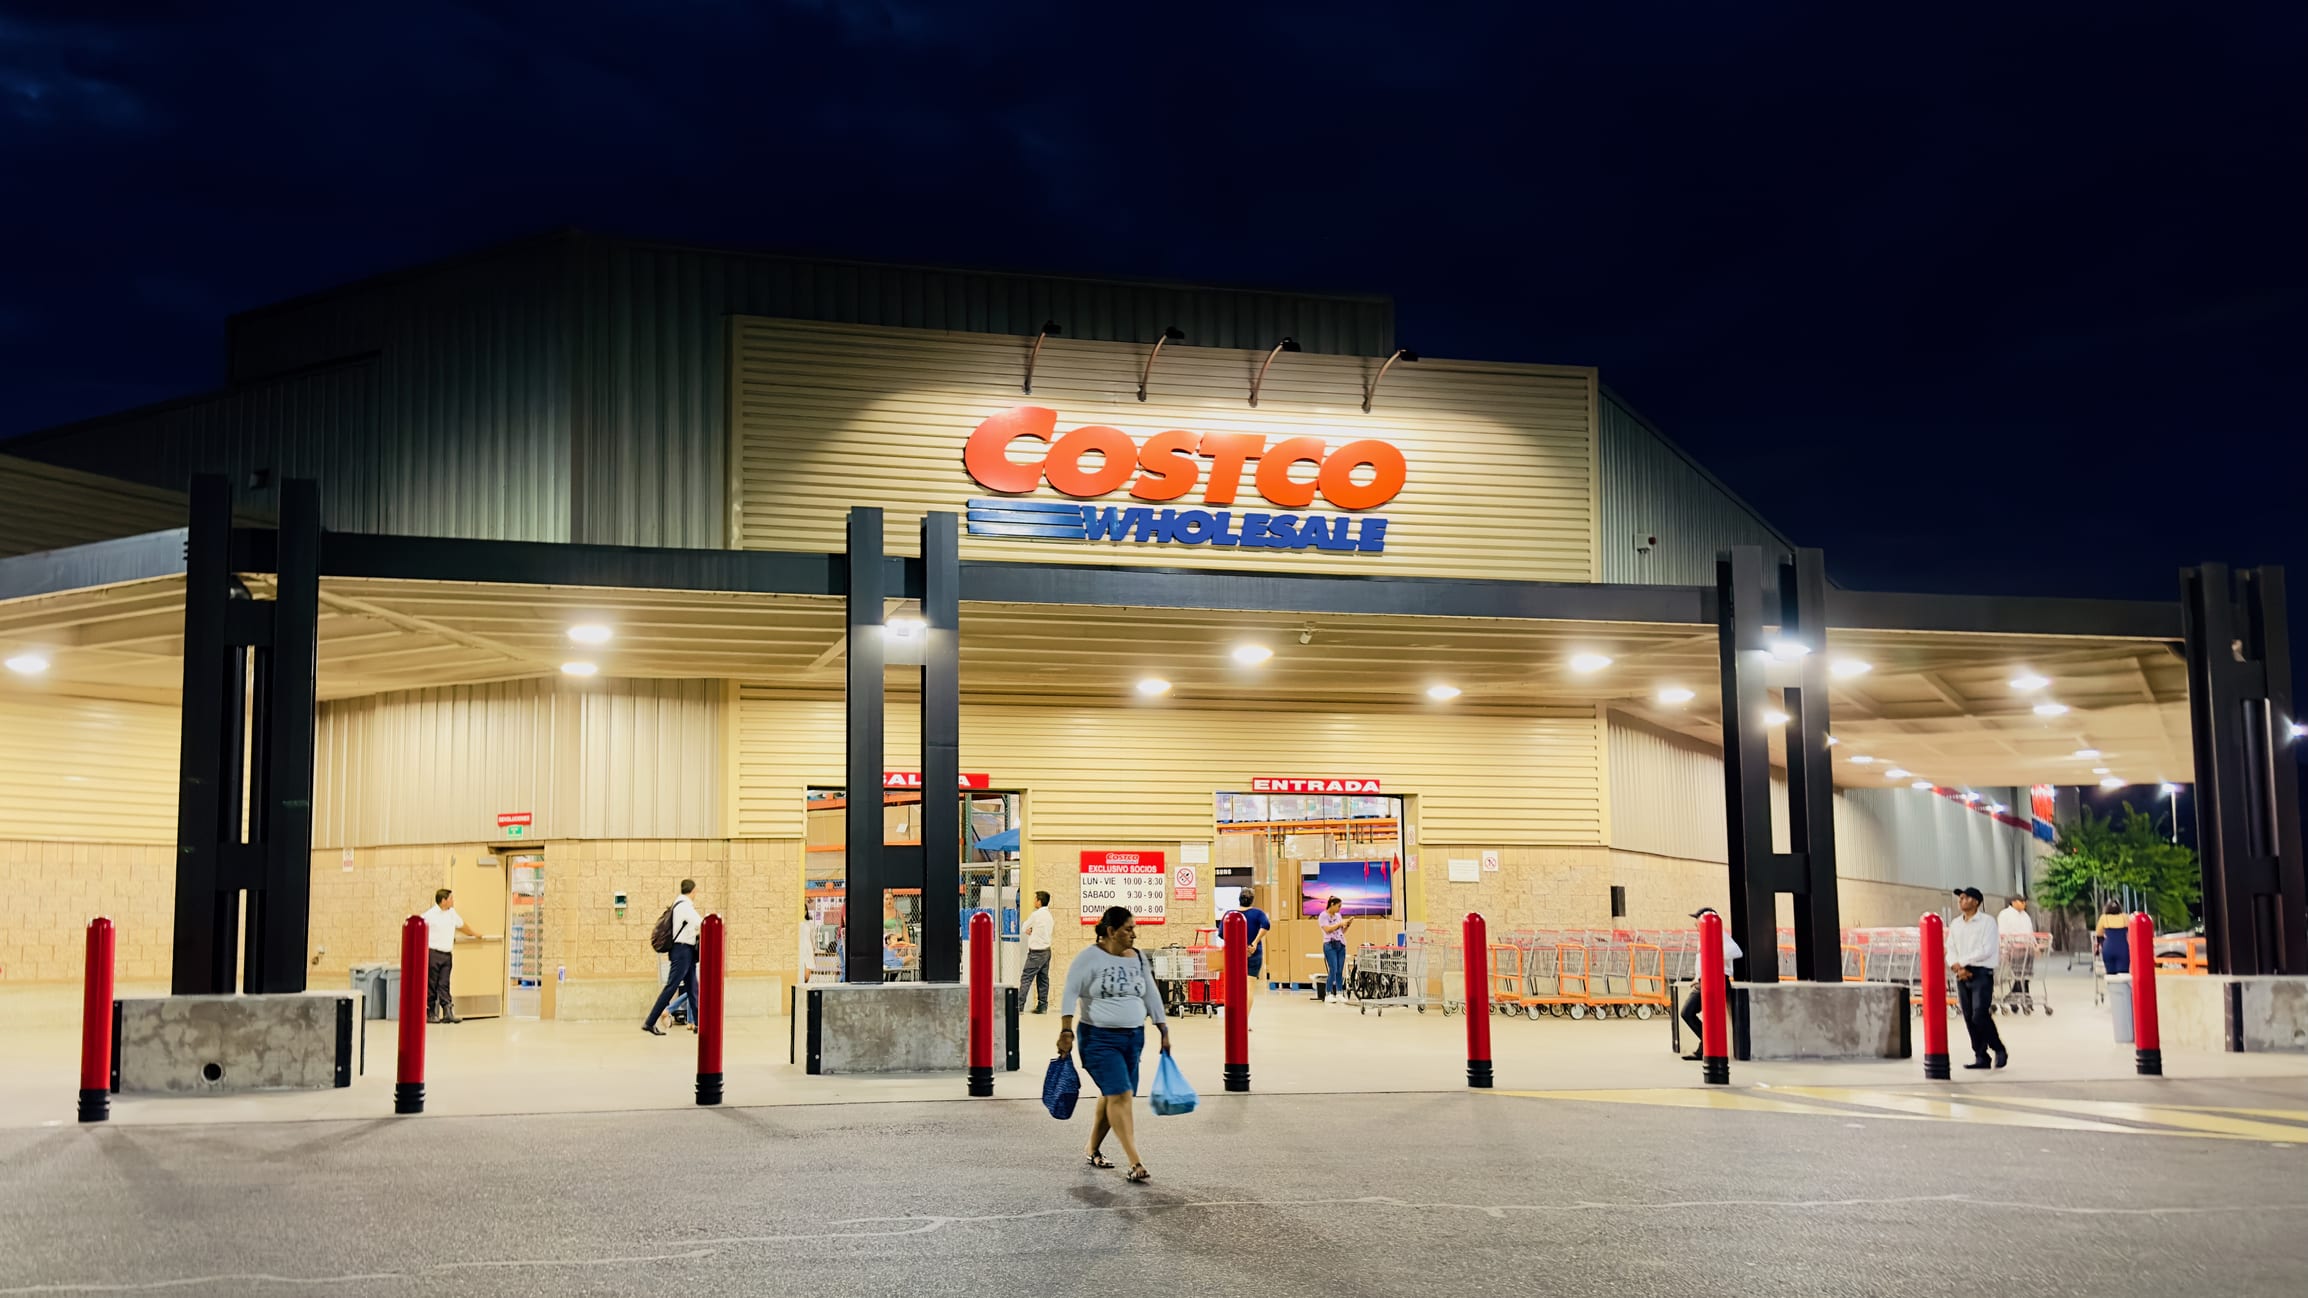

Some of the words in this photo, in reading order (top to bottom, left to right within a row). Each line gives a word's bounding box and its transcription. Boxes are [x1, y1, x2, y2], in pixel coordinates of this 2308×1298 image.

[964, 406, 1407, 510] COSTCO
[1081, 506, 1388, 552] WHOLESALE
[883, 773, 972, 786] ALA
[1253, 779, 1379, 792] ENTRADA
[1088, 865, 1129, 873] EXCLUSIVO
[1130, 865, 1158, 873] SOCIOS
[1082, 877, 1099, 886] LUN
[1104, 877, 1116, 886] VIE
[1082, 904, 1112, 914] DOMIN
